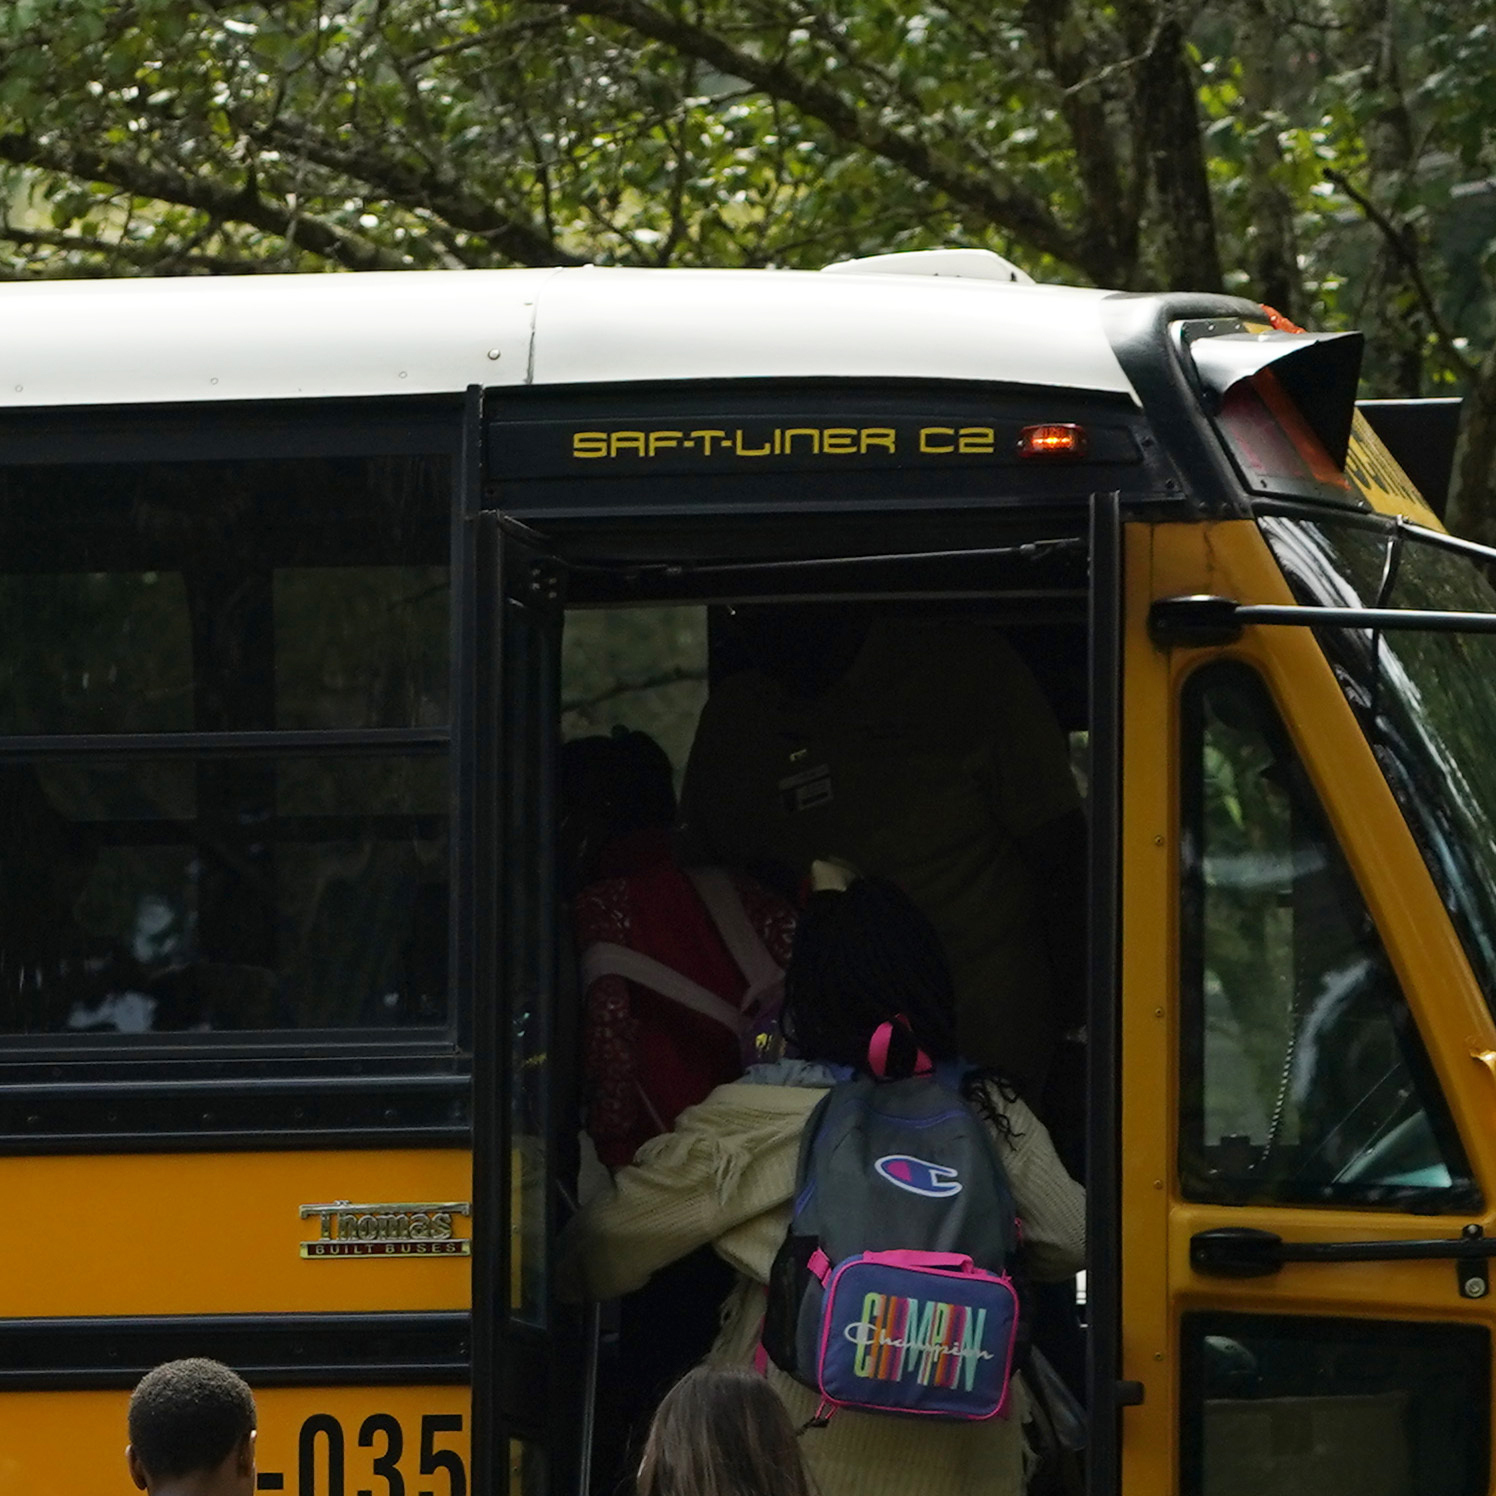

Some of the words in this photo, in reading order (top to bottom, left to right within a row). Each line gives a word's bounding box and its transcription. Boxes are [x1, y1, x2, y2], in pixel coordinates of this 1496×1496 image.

[573, 427, 896, 457] SAF-T-LINER
[919, 427, 994, 453] C2
[310, 1201, 460, 1241] Thomas
[315, 1243, 374, 1254] BUILT
[385, 1242, 457, 1254] BUSES
